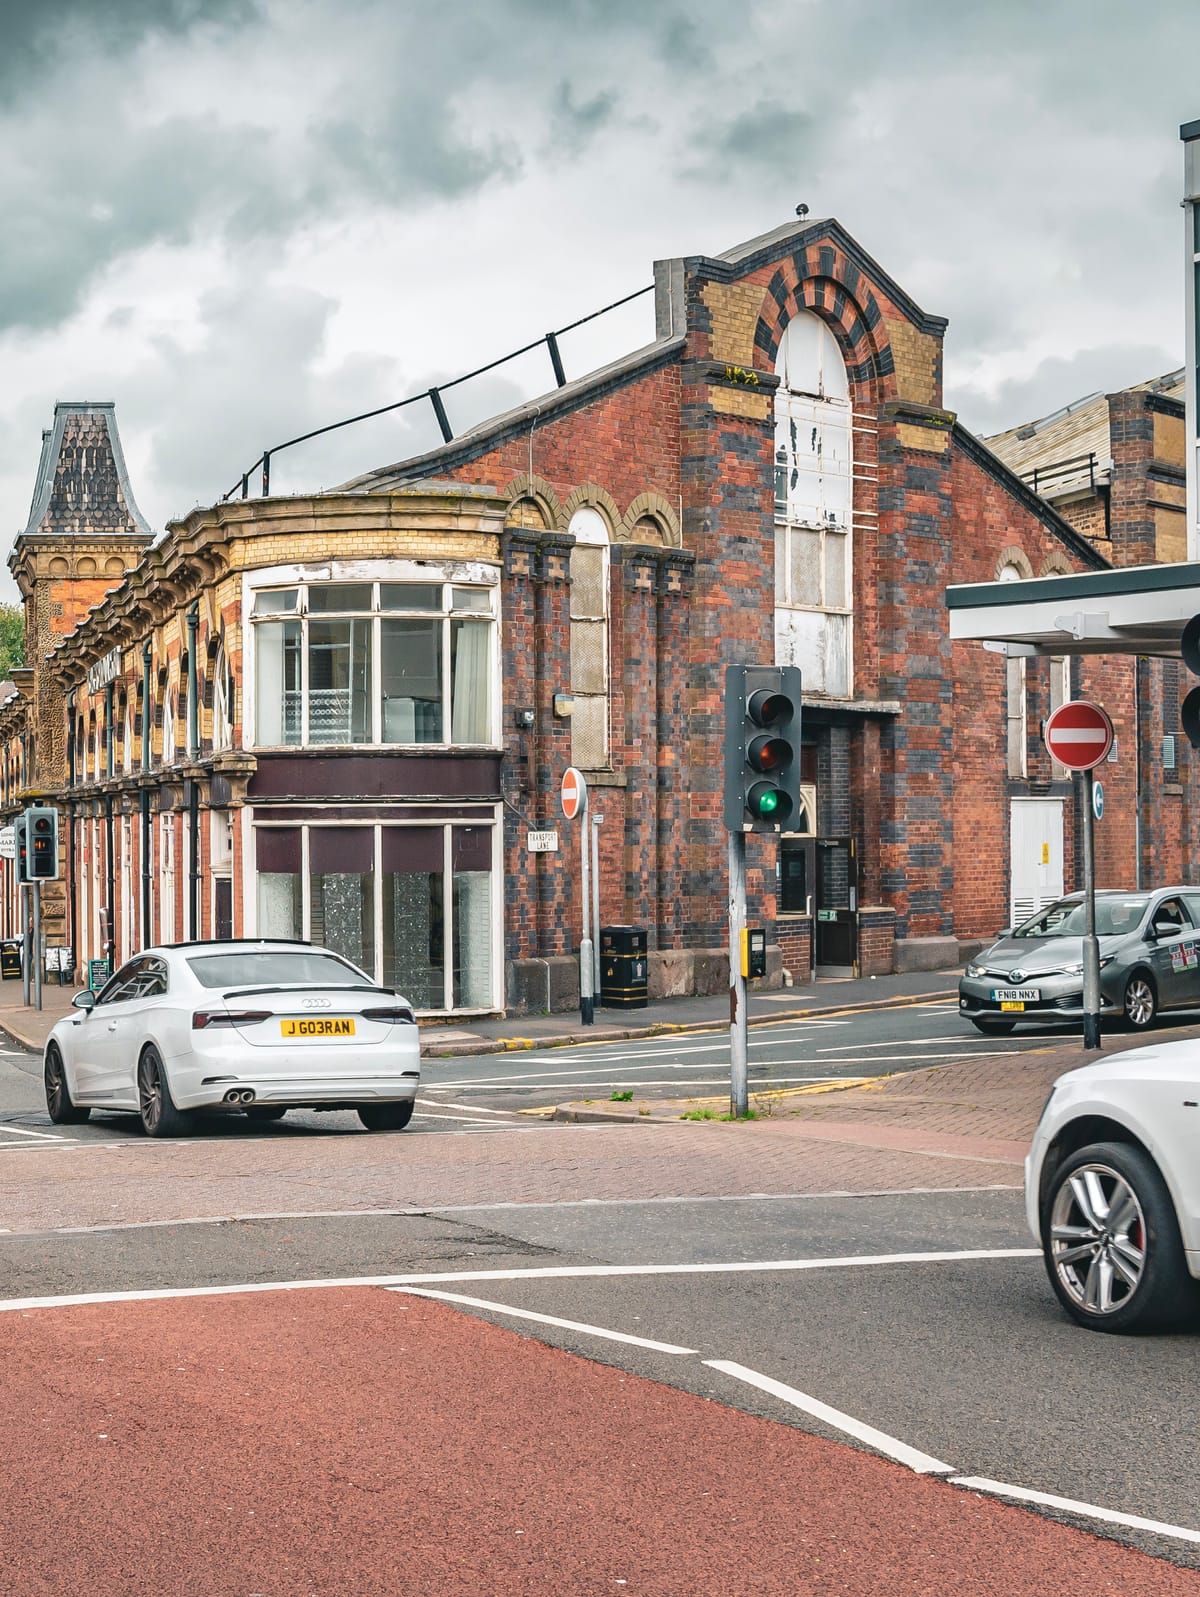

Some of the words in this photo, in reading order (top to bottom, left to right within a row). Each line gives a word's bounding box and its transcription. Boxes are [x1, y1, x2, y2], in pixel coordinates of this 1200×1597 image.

[529, 832, 557, 842] TRANSPORT
[537, 841, 550, 850] LANE
[1018, 990, 1036, 1000] NNX
[288, 1022, 296, 1035] J
